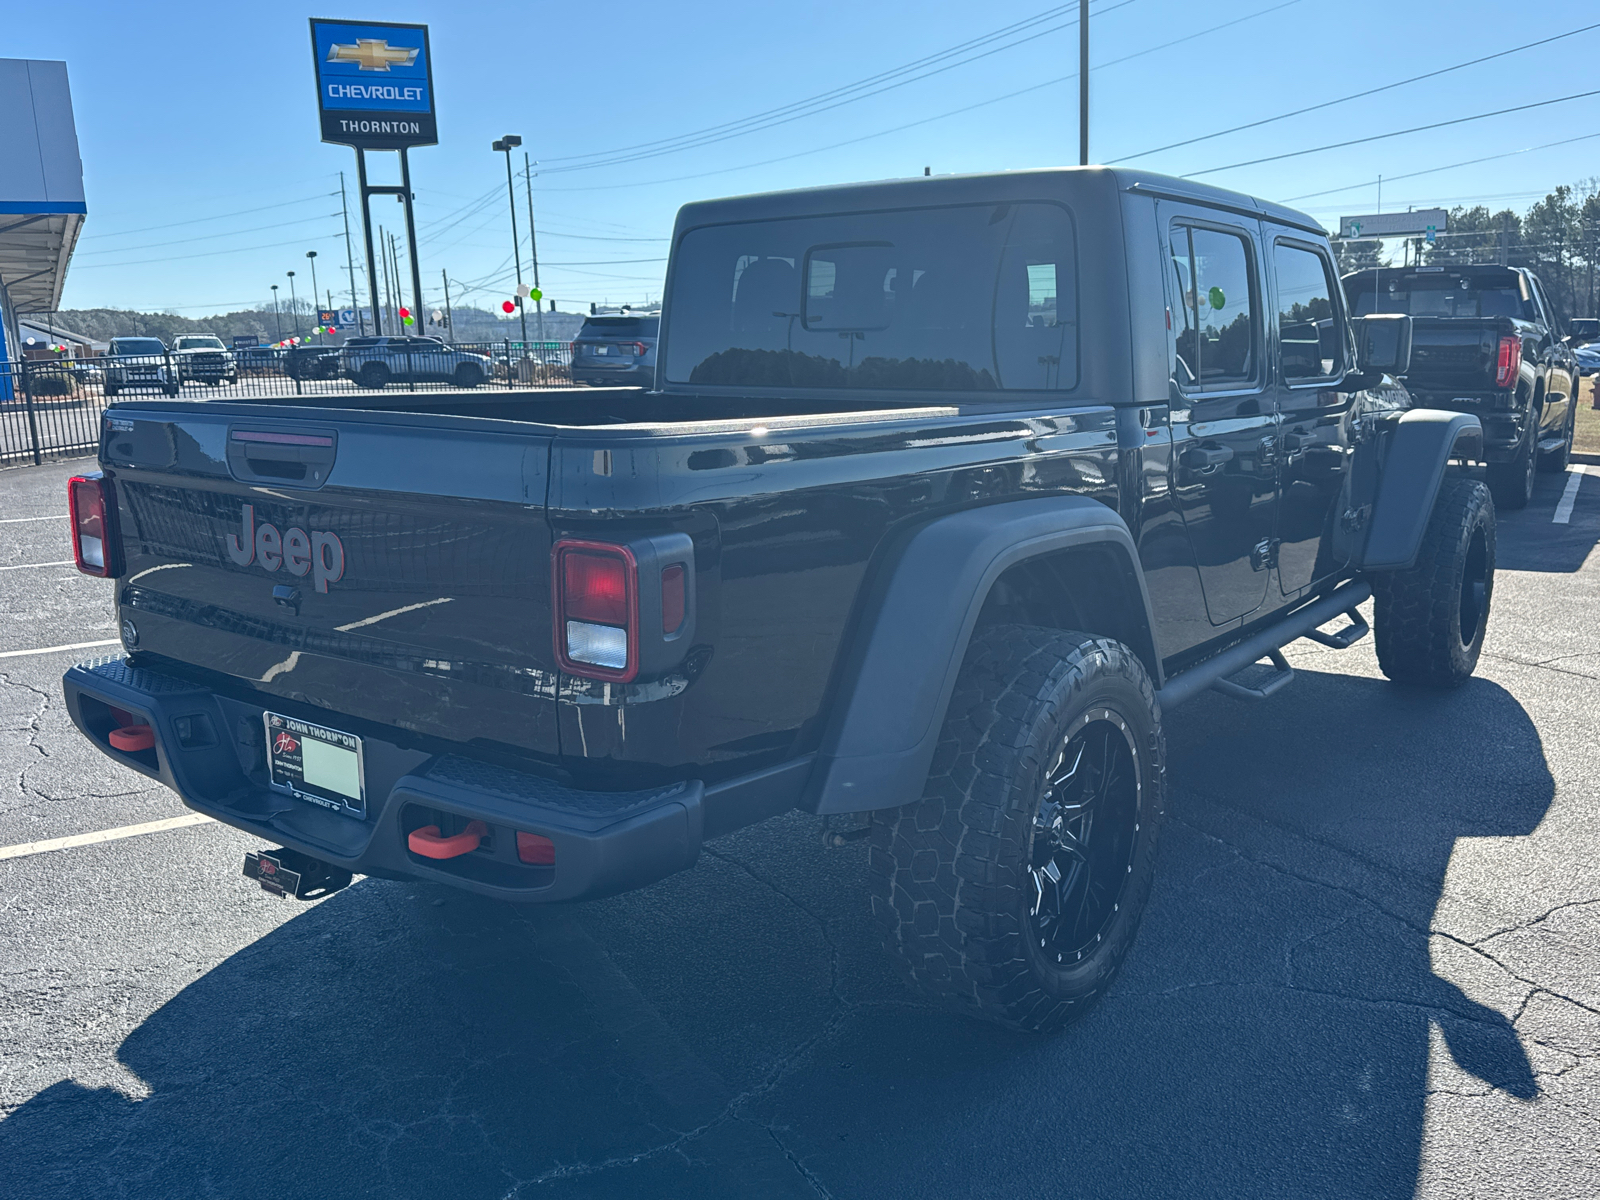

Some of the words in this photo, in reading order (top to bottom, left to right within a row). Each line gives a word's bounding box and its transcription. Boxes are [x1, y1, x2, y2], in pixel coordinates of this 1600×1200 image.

[328, 84, 423, 101] CHEVROLET
[340, 120, 420, 134] THORNTON
[227, 504, 345, 594] Jeep
[286, 719, 309, 734] JOHN
[309, 725, 356, 748] THORNTON
[302, 794, 331, 808] CHEVROLET
